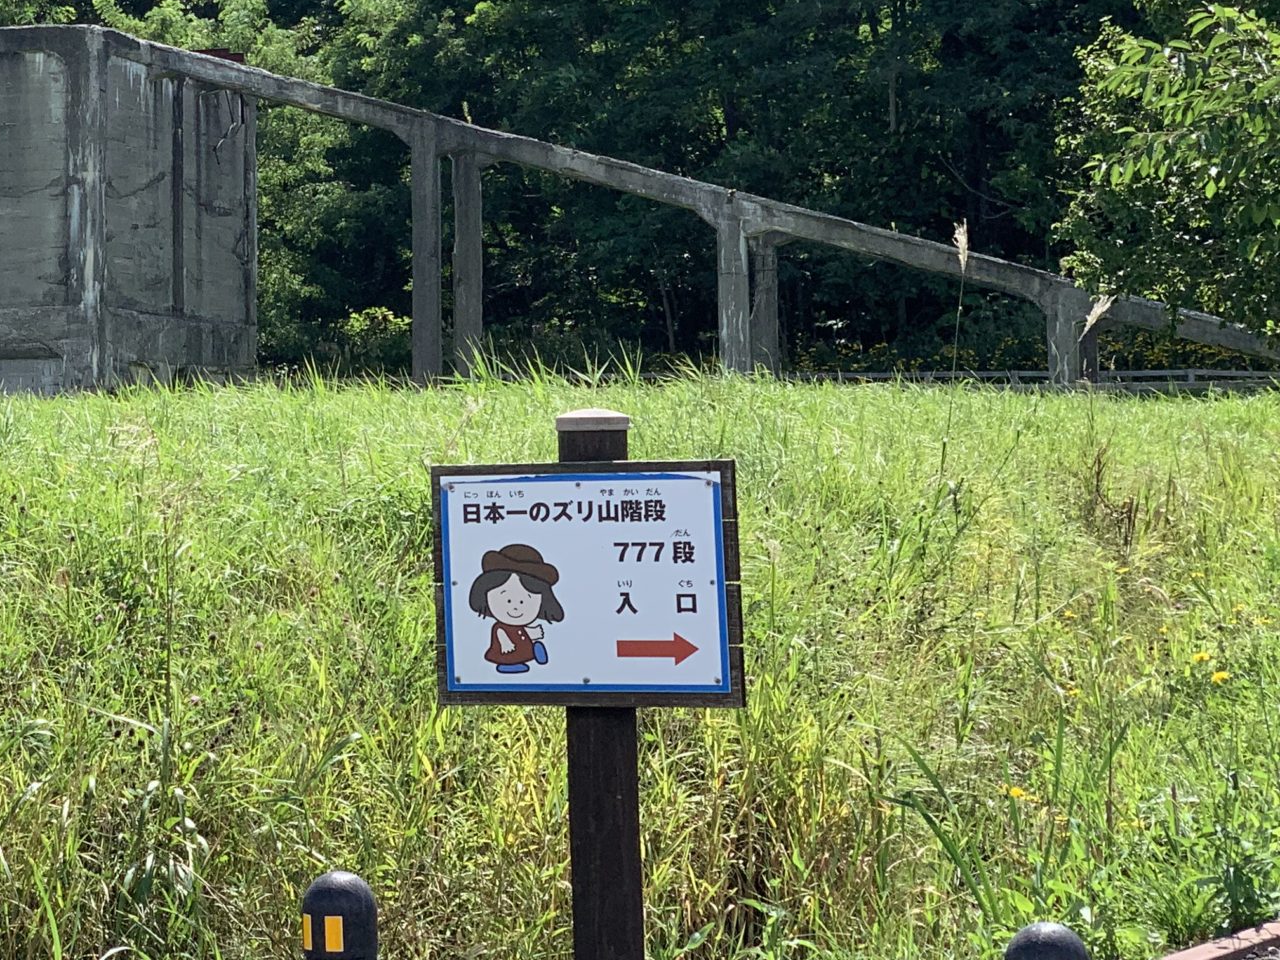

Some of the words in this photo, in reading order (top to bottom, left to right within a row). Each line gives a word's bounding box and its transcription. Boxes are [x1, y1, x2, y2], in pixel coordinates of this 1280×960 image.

[462, 498, 667, 524] 日本一のズリ山階段
